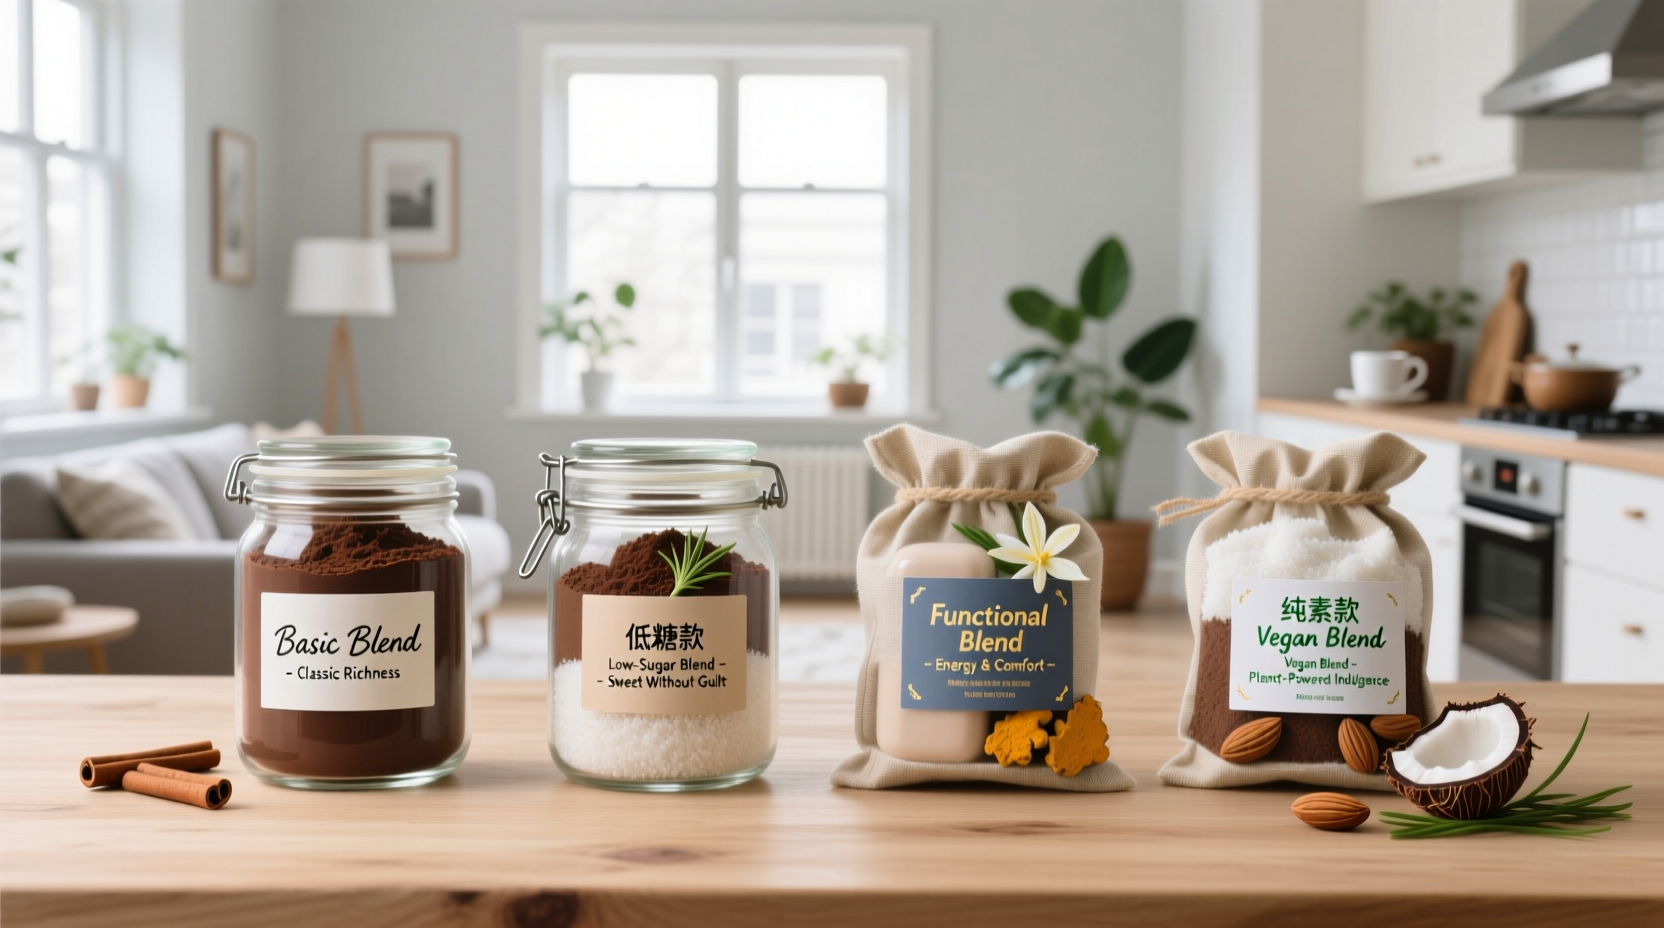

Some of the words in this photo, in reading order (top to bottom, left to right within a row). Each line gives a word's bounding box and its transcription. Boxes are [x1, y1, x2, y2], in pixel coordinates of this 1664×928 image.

[930, 603, 1048, 626] Functional
[1280, 596, 1359, 624] 纯素款
[275, 624, 340, 657] Basic
[347, 623, 422, 657] Blend
[625, 623, 704, 651] 低糖款
[959, 629, 1024, 652] Blend
[1257, 625, 1318, 654] Vegan
[1326, 626, 1387, 648] Blend
[297, 666, 340, 680] Classic
[344, 666, 400, 680] Richness
[608, 658, 677, 674] Low-Sugar
[680, 657, 715, 670] Blend
[936, 658, 977, 674] Energy
[981, 658, 990, 671] &
[994, 657, 1044, 671] Comfort
[1320, 657, 1349, 669] Blend
[608, 675, 643, 688] Sweet
[646, 675, 695, 689] Without
